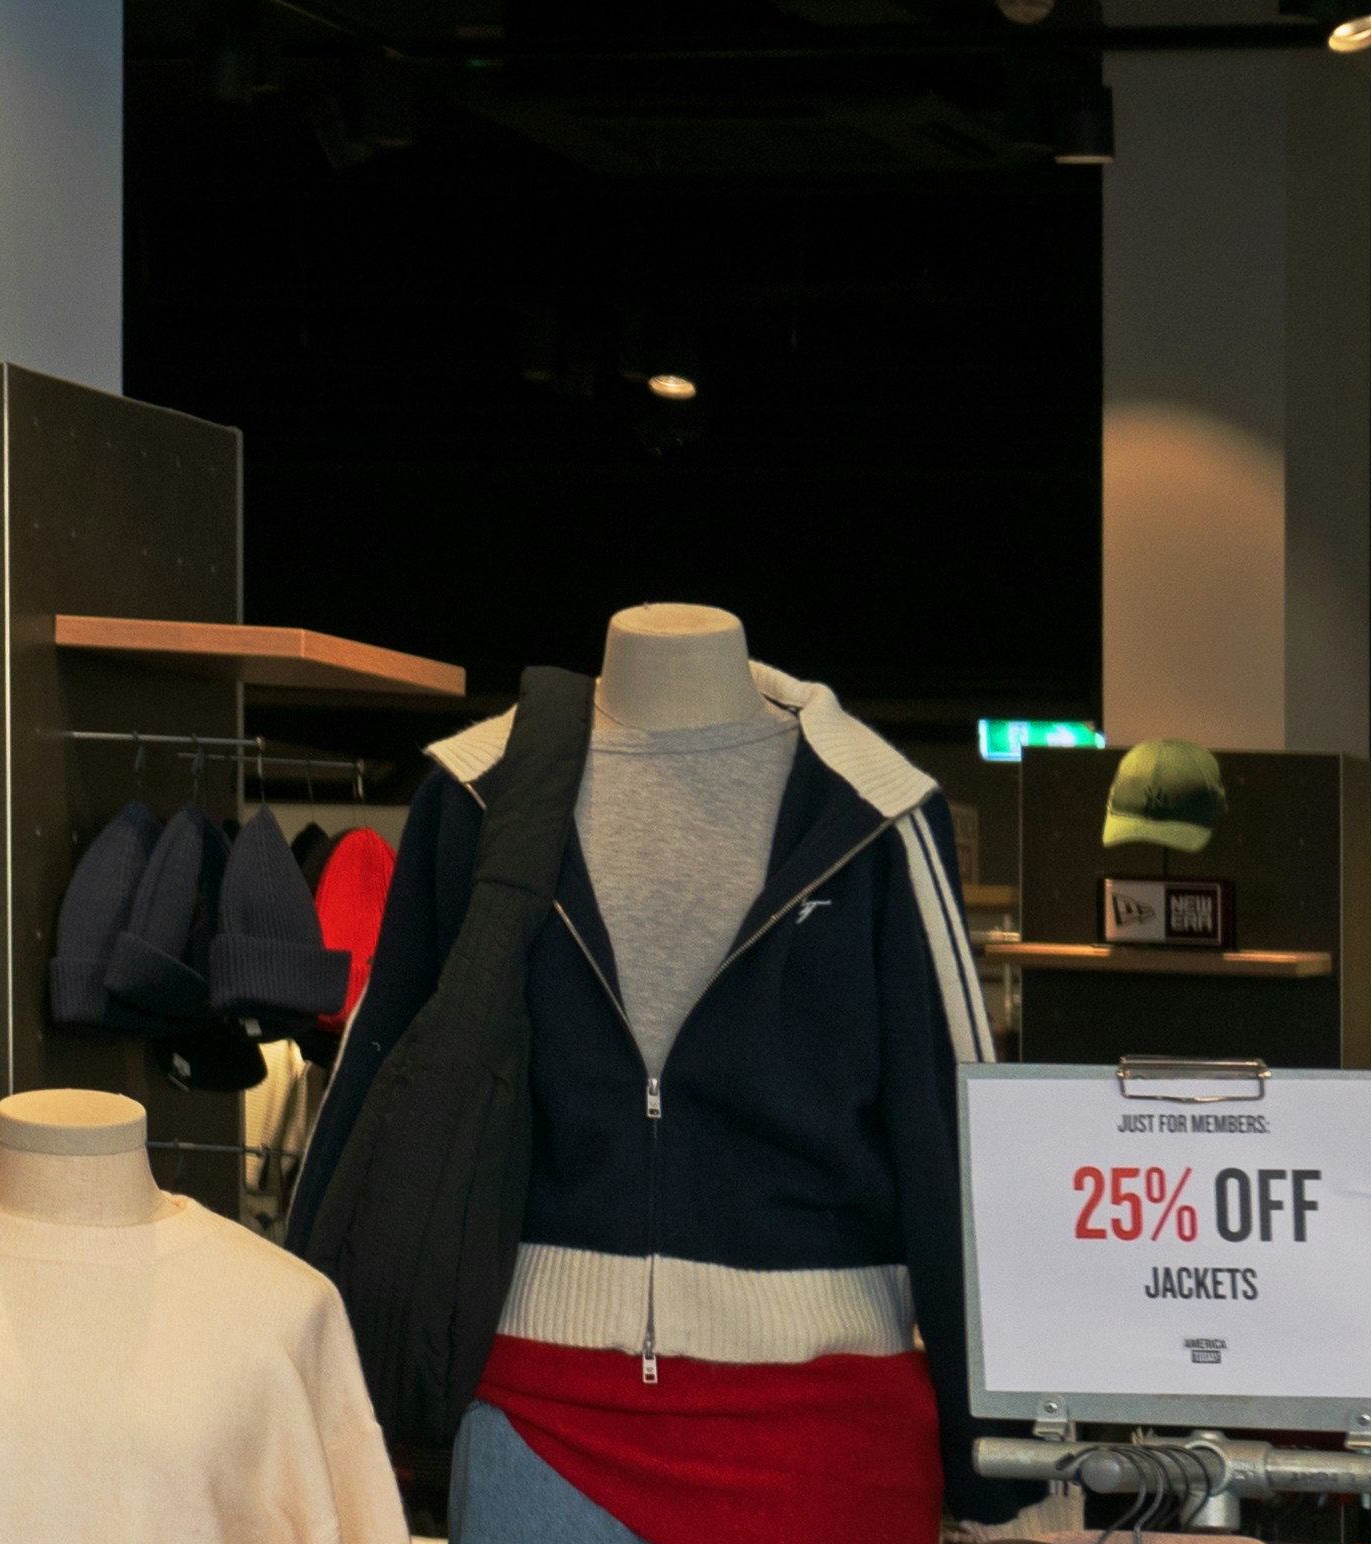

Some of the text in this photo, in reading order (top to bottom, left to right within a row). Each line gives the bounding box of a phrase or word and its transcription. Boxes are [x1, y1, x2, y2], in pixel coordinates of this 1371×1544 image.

[1170, 894, 1213, 912] NEW
[1170, 912, 1213, 934] ERA
[1117, 1114, 1155, 1133] JUST
[1158, 1114, 1188, 1133] FOR
[1072, 1166, 1322, 1243] 25% OFF
[1144, 1266, 1259, 1301] JACKETS
